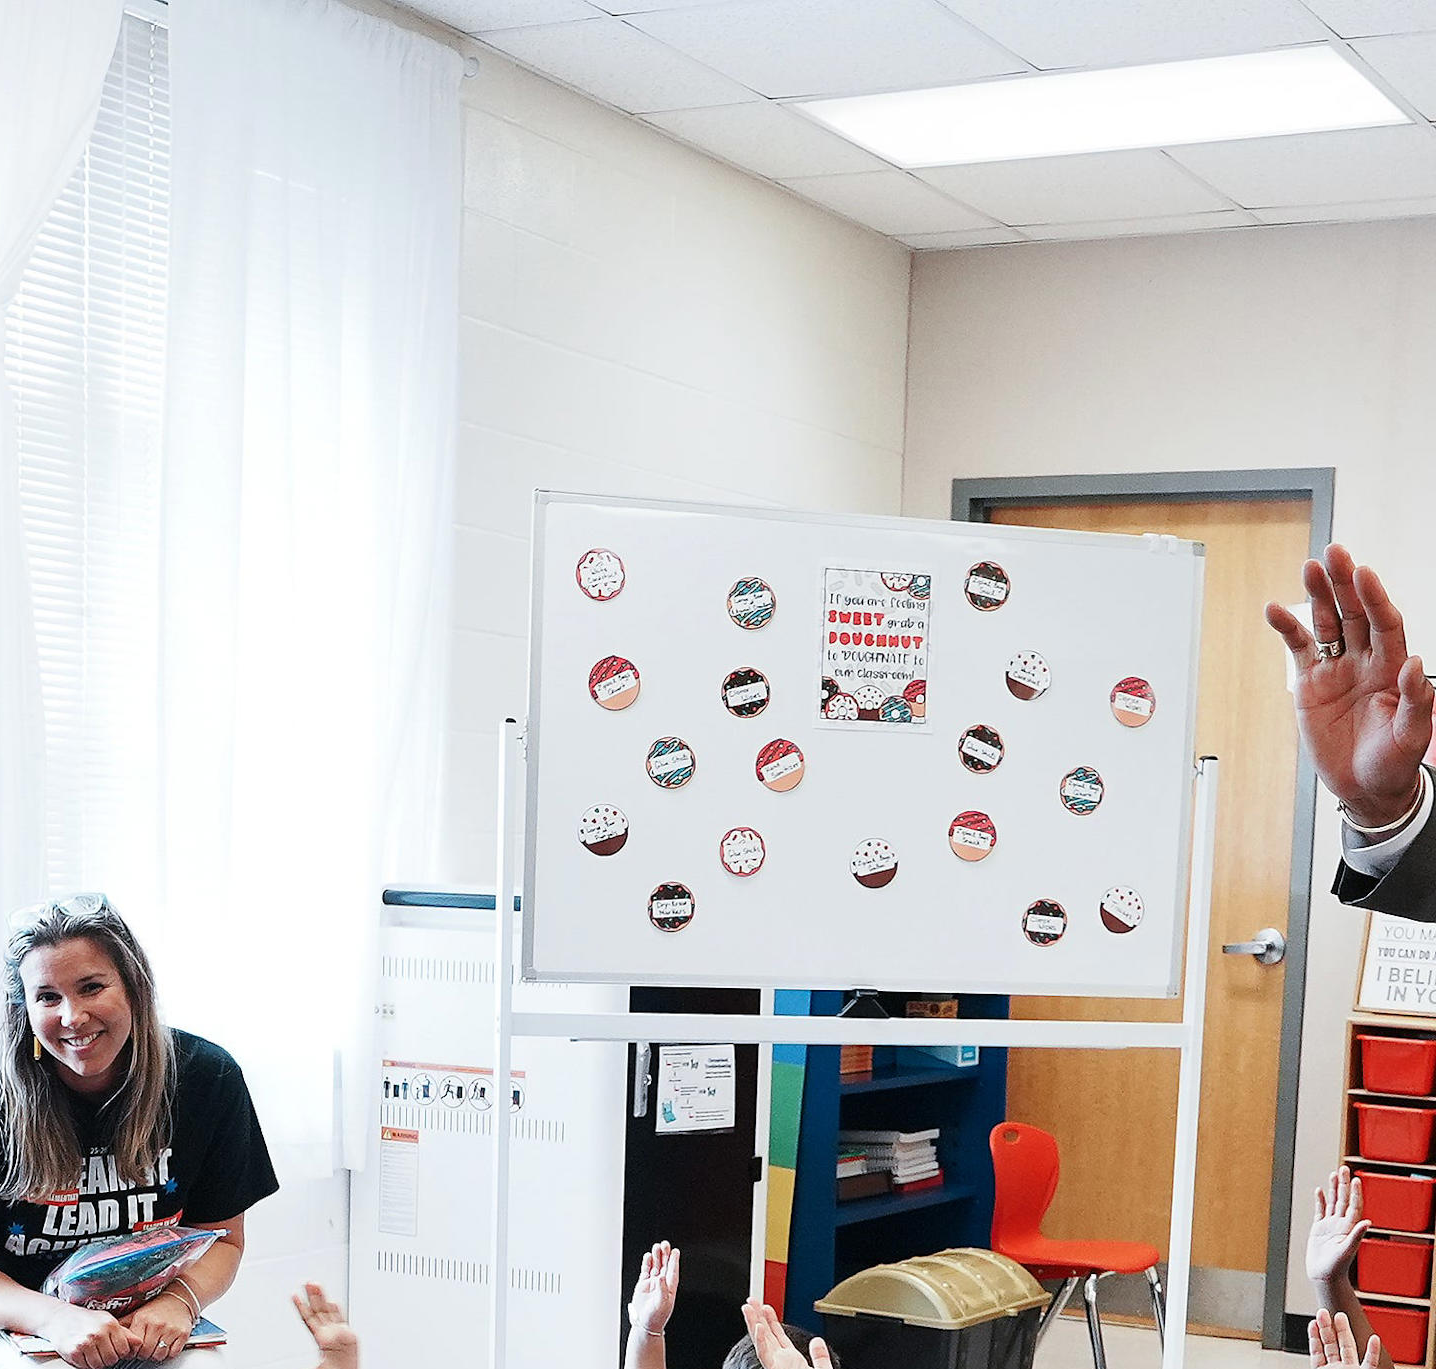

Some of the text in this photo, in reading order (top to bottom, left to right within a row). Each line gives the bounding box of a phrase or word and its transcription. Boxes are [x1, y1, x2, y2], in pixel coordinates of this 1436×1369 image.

[830, 593, 925, 611] If you are feeling
[828, 609, 924, 629] SWEET grab a
[828, 631, 924, 649] DOUGHNUT
[827, 650, 837, 661] to
[914, 655, 924, 666] to
[834, 668, 853, 677] our
[1384, 926, 1415, 940] YOU
[1378, 947, 1396, 958] YOU
[1398, 949, 1416, 960] CAN
[1419, 950, 1430, 960] DO
[1386, 985, 1407, 1002] IN
[42, 1193, 157, 1236] LEAD IT
